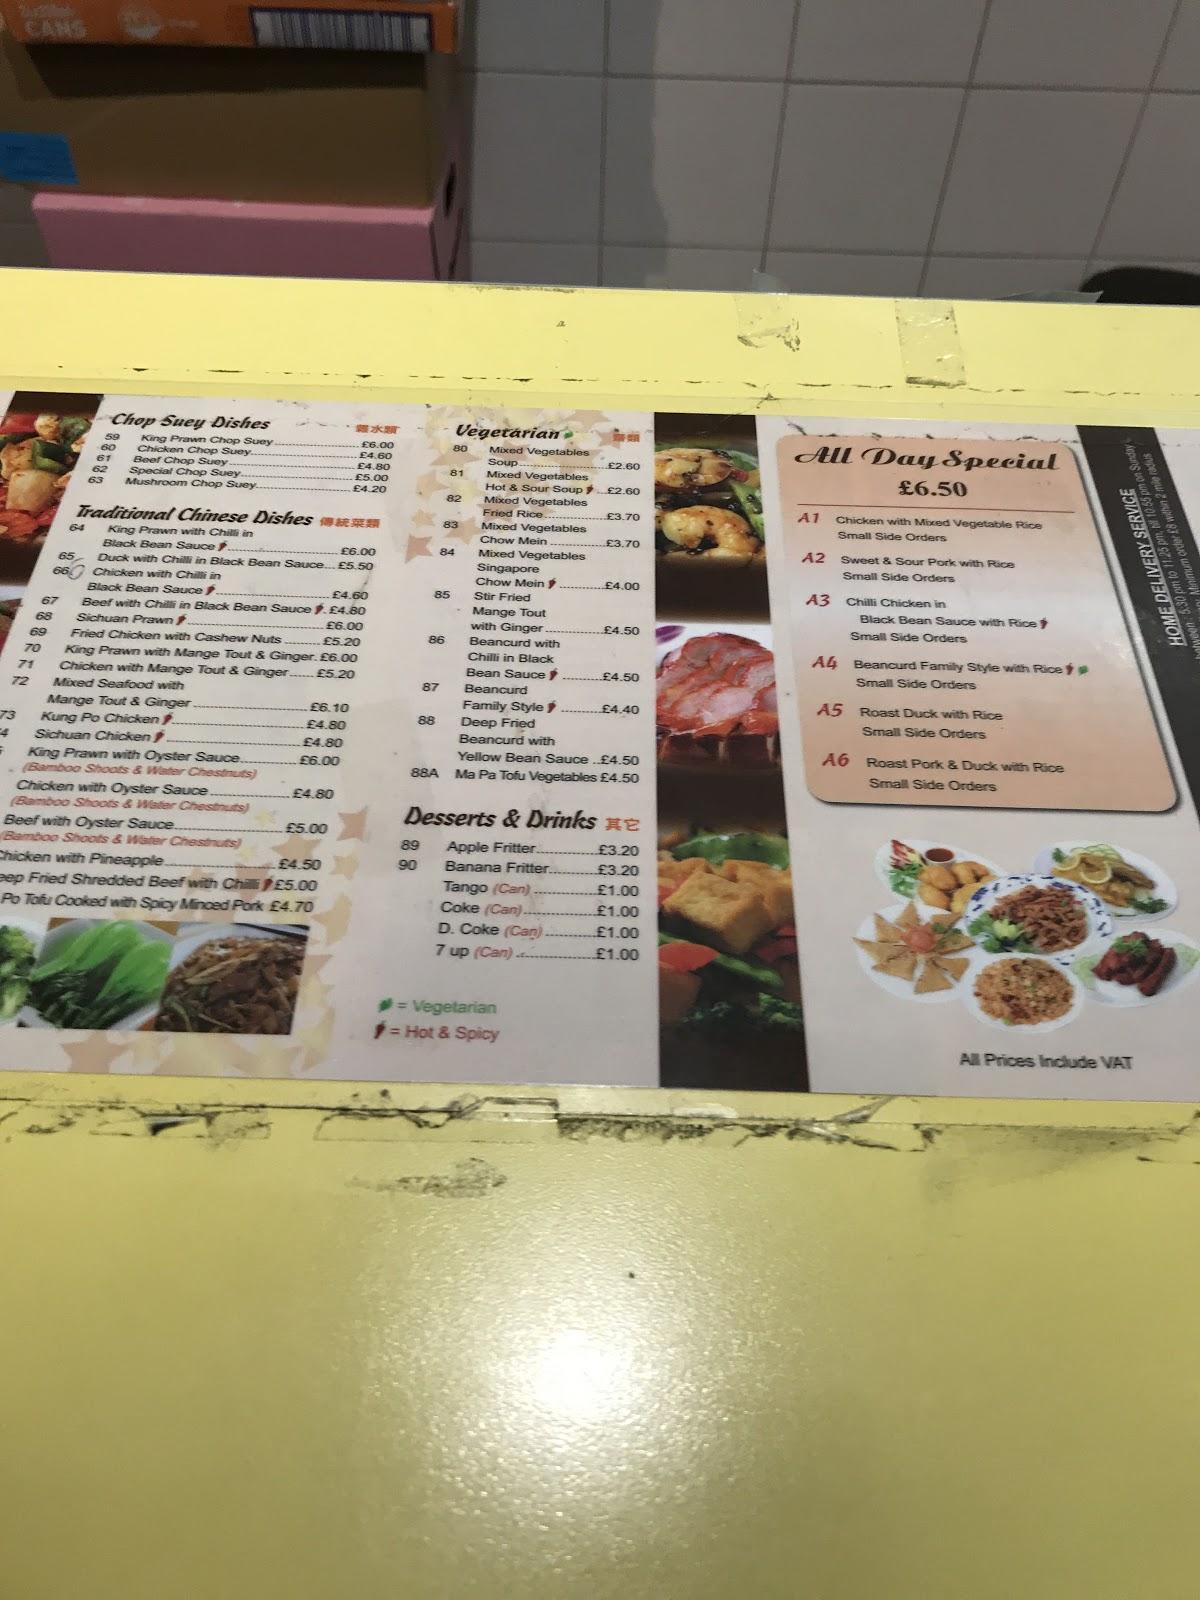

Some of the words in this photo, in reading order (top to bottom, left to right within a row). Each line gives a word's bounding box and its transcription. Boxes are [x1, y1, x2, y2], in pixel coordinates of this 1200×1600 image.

[111, 413, 156, 430] Chop
[160, 414, 204, 431] Suey
[211, 416, 271, 430] Dishes
[104, 433, 120, 441] 59
[140, 433, 167, 445] King
[169, 435, 207, 445] Prawn
[209, 436, 241, 447] Chop
[243, 437, 274, 447] Suey
[361, 440, 395, 449] £6.00
[455, 424, 560, 441] Vegetarian
[100, 443, 117, 452] 60
[137, 444, 185, 455] Chicken
[187, 446, 218, 457] Chop
[220, 447, 252, 458] Suey
[359, 451, 393, 460] £4.60
[453, 445, 468, 453] 80
[489, 446, 523, 455] Mixed
[527, 447, 590, 457] Vegetables
[794, 446, 852, 464] All
[861, 447, 939, 470] Day
[942, 449, 1060, 471] Special
[96, 454, 112, 463] 61
[133, 455, 165, 465] Beef
[166, 457, 195, 467] Chop
[198, 457, 228, 467] Suey
[357, 462, 391, 471] £4.80
[488, 458, 518, 468] Soup
[608, 462, 641, 471] £2.60
[450, 469, 464, 477] 81
[486, 471, 521, 480] Mixed
[525, 472, 589, 482] Vegetables
[485, 483, 507, 492] Hot
[509, 483, 518, 492] &
[521, 484, 549, 494] Sour
[552, 485, 584, 495] Soup
[607, 487, 641, 496] £2.60
[898, 480, 968, 497] £6.50
[76, 504, 175, 522] Traditional
[177, 507, 249, 523] Chinese
[252, 509, 315, 526] Dishes
[797, 512, 820, 523] A1
[835, 516, 884, 526] Chicken
[886, 517, 912, 527] with
[915, 517, 951, 528] Mixed
[953, 519, 1012, 530] Vegetable
[1015, 520, 1043, 530] Rice
[1119, 488, 1150, 539] SERVICE
[838, 531, 872, 540] Small
[875, 532, 902, 541] Side
[905, 533, 947, 543] Orders
[477, 563, 540, 574] Singapore
[801, 552, 825, 564] A2
[841, 556, 880, 566] Sweet
[883, 557, 892, 566] &
[895, 557, 925, 567] Sour
[928, 558, 956, 568] Pork
[958, 558, 984, 569] with
[987, 559, 1015, 569] Rice
[1136, 542, 1170, 603] DELIVERY
[806, 594, 830, 607] A3
[845, 597, 877, 608] Chilli
[880, 598, 931, 609] Chicken
[934, 599, 947, 609] in
[35, 611, 53, 621] 68
[76, 612, 129, 625] Sichuan
[132, 615, 174, 625] Prawn
[325, 621, 364, 631] £6.00
[1156, 605, 1184, 647] HOME
[30, 627, 47, 637] 69
[70, 628, 104, 640] Fried
[106, 629, 162, 641] Chicken
[163, 631, 191, 641] with
[194, 631, 249, 644] Cashew
[251, 634, 282, 645] Nuts
[322, 637, 361, 647] £5.20
[812, 655, 838, 670] A4
[854, 659, 917, 671] Beancurd
[920, 661, 964, 673] Family
[967, 662, 1000, 674] Style
[1003, 663, 1030, 673] with
[1033, 664, 1063, 674] Rice
[422, 682, 440, 692] 87
[464, 684, 528, 695] Beancurd
[463, 700, 507, 713] Family
[511, 702, 544, 713] Style
[601, 705, 640, 715] £4.40
[41, 711, 77, 726] Kung
[80, 712, 100, 723] Po
[104, 712, 160, 725] Chicken
[306, 720, 347, 731] £4.80
[22, 761, 81, 774] (Bamboo
[84, 763, 129, 775] Shoots
[133, 765, 143, 775] &
[146, 765, 185, 777] Water
[187, 767, 257, 780] Chestnuts)
[822, 753, 849, 767] A6
[866, 757, 908, 770] Roast
[911, 758, 943, 770] Pork
[947, 759, 957, 770] &
[962, 760, 998, 772] Duck
[1001, 762, 1030, 773] with
[1033, 762, 1065, 773] Rice
[410, 768, 439, 778] 88A
[455, 769, 476, 780] Ma
[478, 769, 497, 780] Pa
[500, 770, 526, 781] Tofu
[529, 771, 598, 783] Vegetables
[600, 773, 640, 783] £4.50
[404, 806, 496, 828] Desserts
[502, 809, 520, 828] &
[526, 810, 598, 830] Drinks
[605, 817, 640, 832] 其它
[400, 840, 420, 850] 89
[446, 841, 489, 854] Apple
[493, 842, 536, 853] Fritter
[599, 845, 640, 856] £3.20
[443, 881, 488, 895] Tango
[492, 883, 531, 896] (Can)
[598, 885, 640, 897] £1.00
[440, 901, 480, 914] Coke
[484, 903, 523, 917] (Can)
[597, 905, 640, 918] £1.00
[437, 922, 455, 935] D.
[460, 923, 500, 936] Coke
[504, 925, 543, 939] (Can)
[596, 926, 640, 939] £1.00
[435, 943, 446, 955] 7
[450, 946, 470, 958] up
[473, 946, 513, 960] (Can)
[596, 948, 640, 961] £1.00
[412, 999, 497, 1015] Vegetarian
[404, 1025, 434, 1039] Hot
[438, 1026, 450, 1039] &
[455, 1027, 500, 1042] Spicy
[959, 1053, 981, 1066] All
[984, 1053, 1036, 1068] Prices
[1039, 1055, 1098, 1069] Include
[1100, 1056, 1134, 1070] VAT
